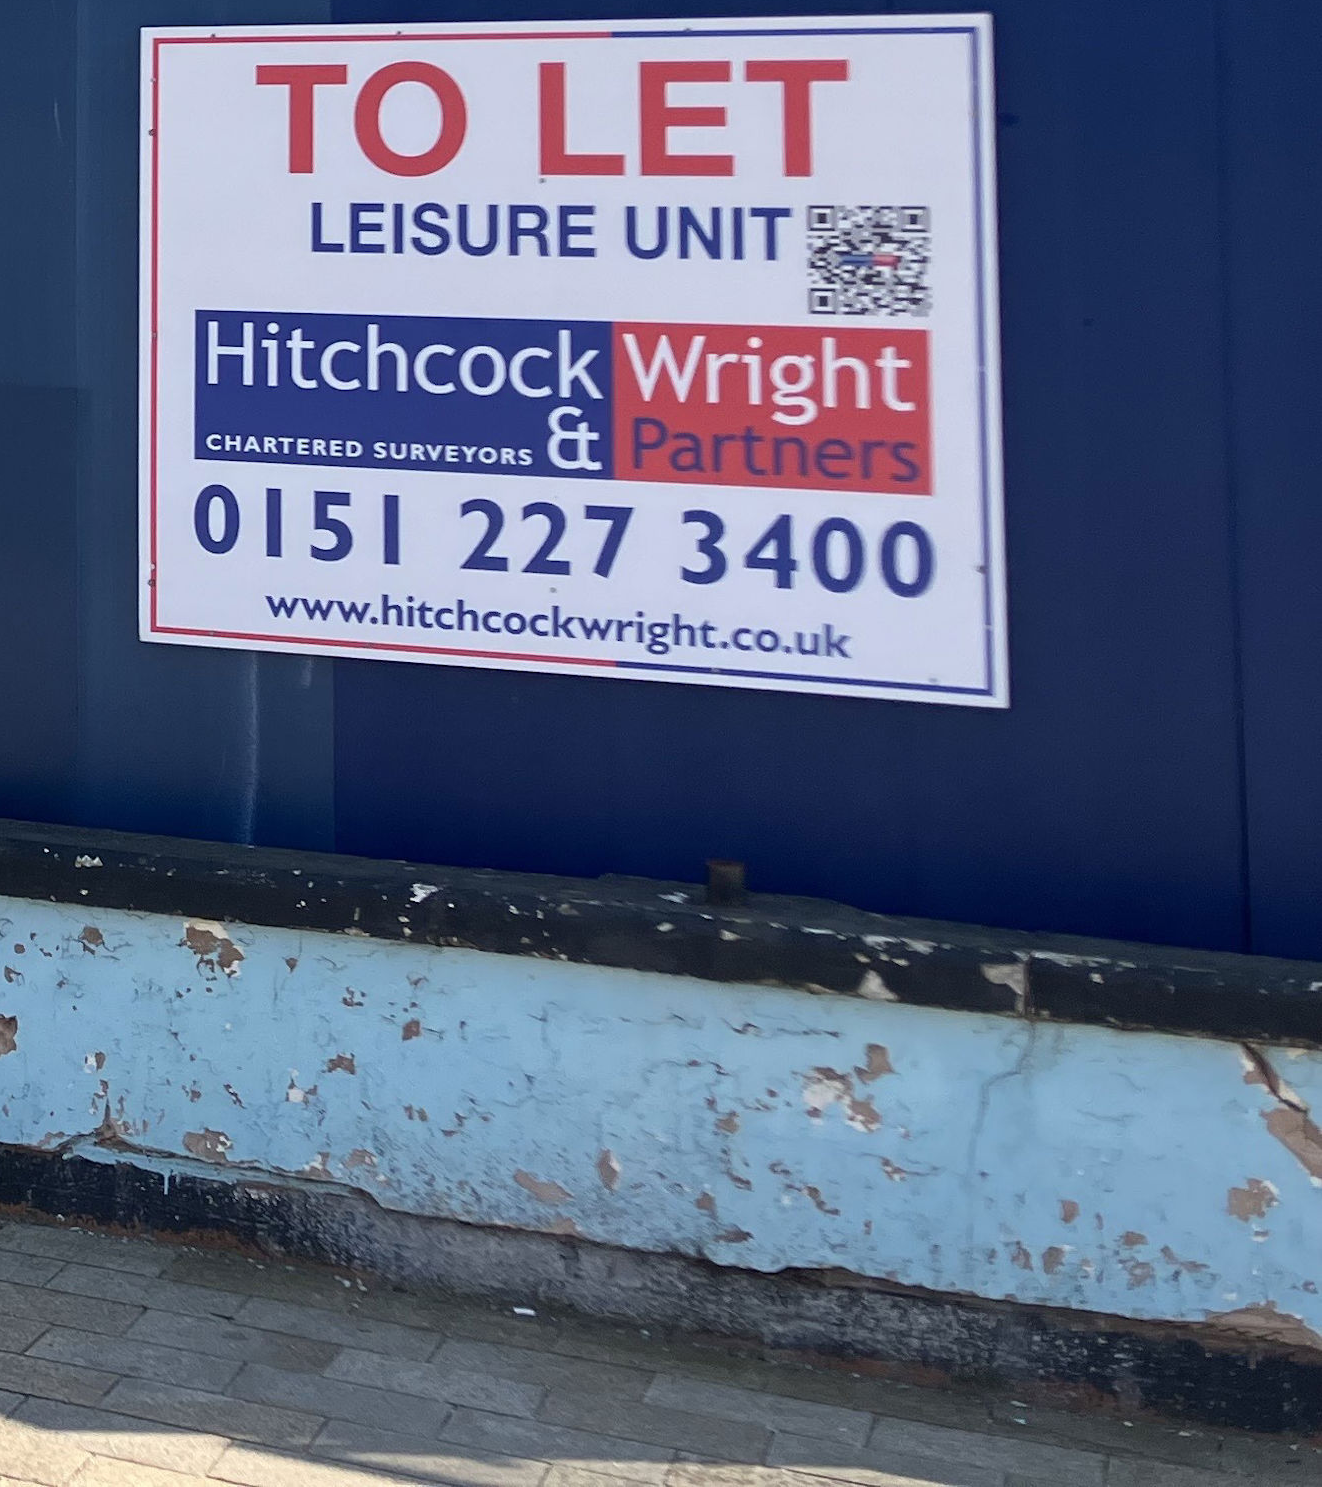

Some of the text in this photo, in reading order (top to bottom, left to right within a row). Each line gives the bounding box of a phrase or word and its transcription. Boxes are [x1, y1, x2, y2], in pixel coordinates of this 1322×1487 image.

[255, 58, 849, 178] TO LET
[310, 201, 791, 261] LEISURE UNIT
[207, 321, 916, 425] Hitchcock Wright
[206, 406, 604, 471] CHARTERED SURVEYORS &
[633, 417, 920, 483] Partners
[194, 484, 935, 598] 0151 227 3400
[265, 594, 852, 659] www.hitchcockwright.co.uk
